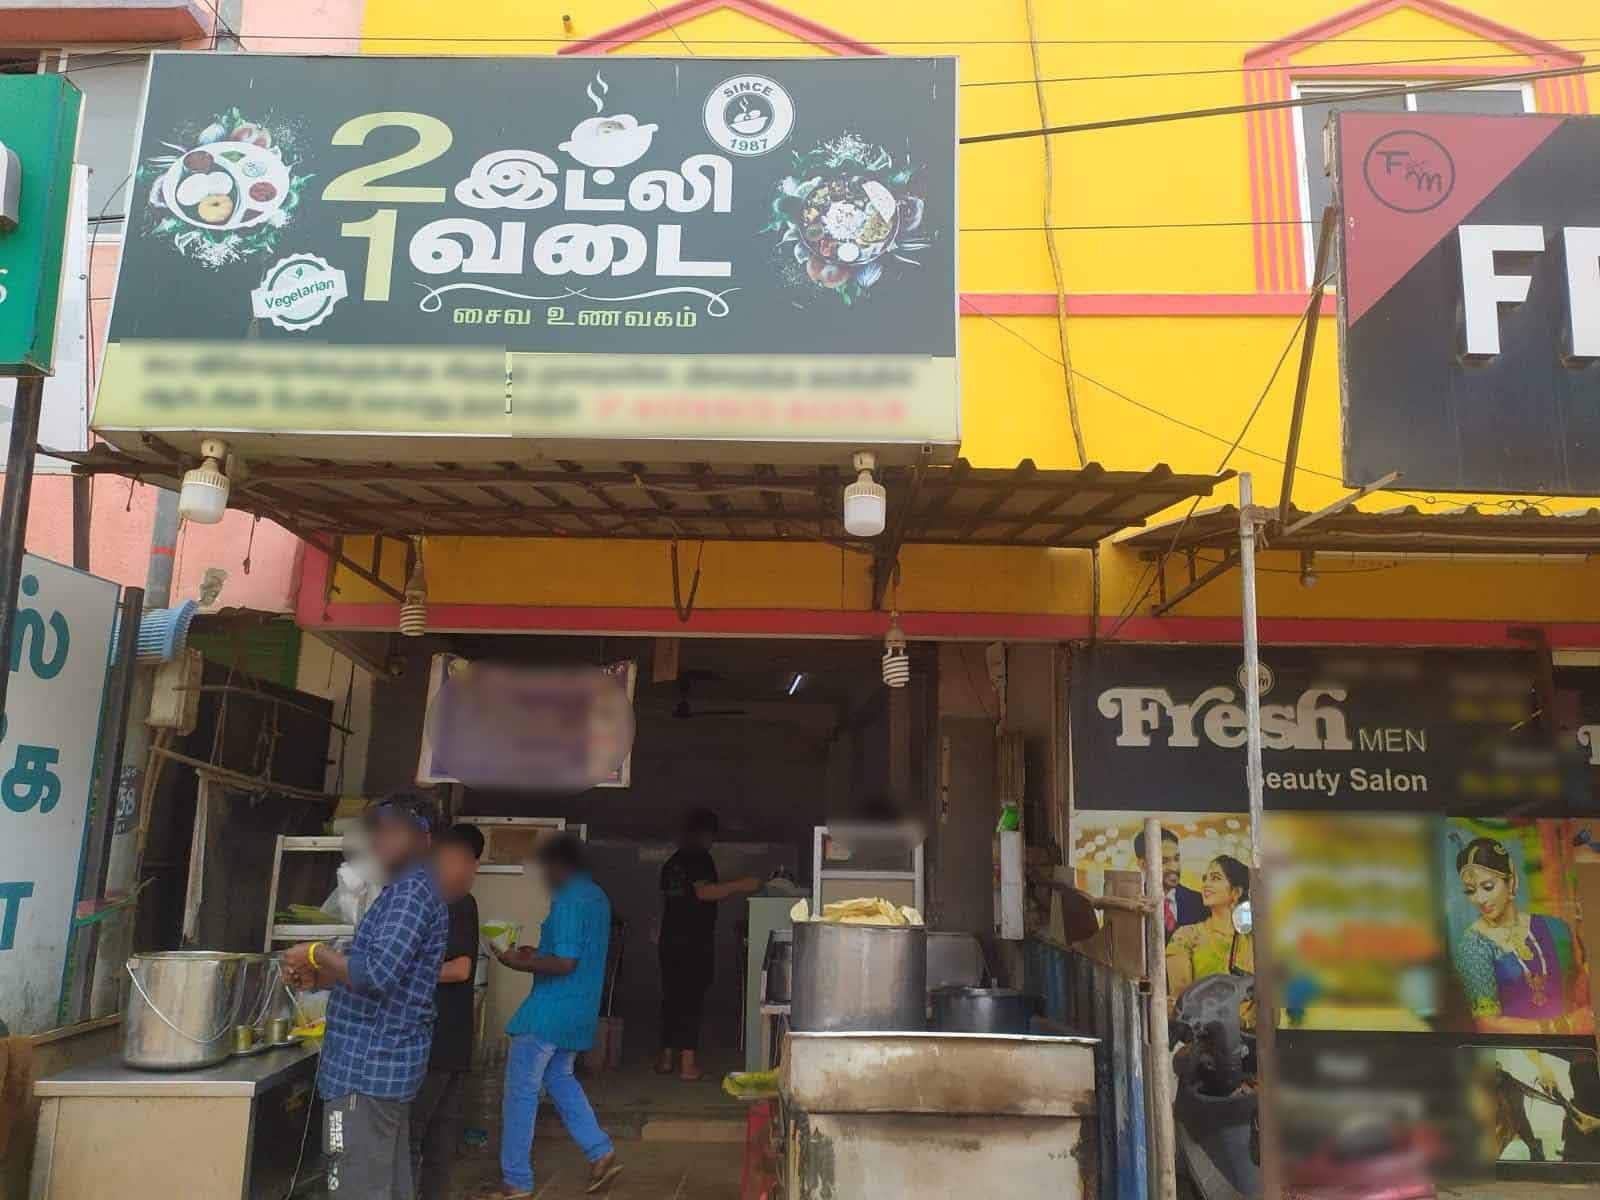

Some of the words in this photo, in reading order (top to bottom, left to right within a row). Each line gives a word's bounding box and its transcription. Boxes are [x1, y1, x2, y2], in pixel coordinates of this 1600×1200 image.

[723, 81, 774, 98] SINCE
[729, 138, 769, 152] 1987
[321, 111, 454, 203] 2
[454, 150, 733, 214] இட்லி
[340, 208, 398, 302] 1
[408, 217, 732, 277] வடை
[264, 279, 335, 309] Vegetarian
[452, 306, 532, 326] சைவ
[546, 305, 697, 328] உணவகம்
[1097, 687, 1352, 750] Fresh
[1359, 728, 1426, 753] MEN
[1246, 767, 1341, 796] eauty
[1349, 767, 1428, 793] Salon
